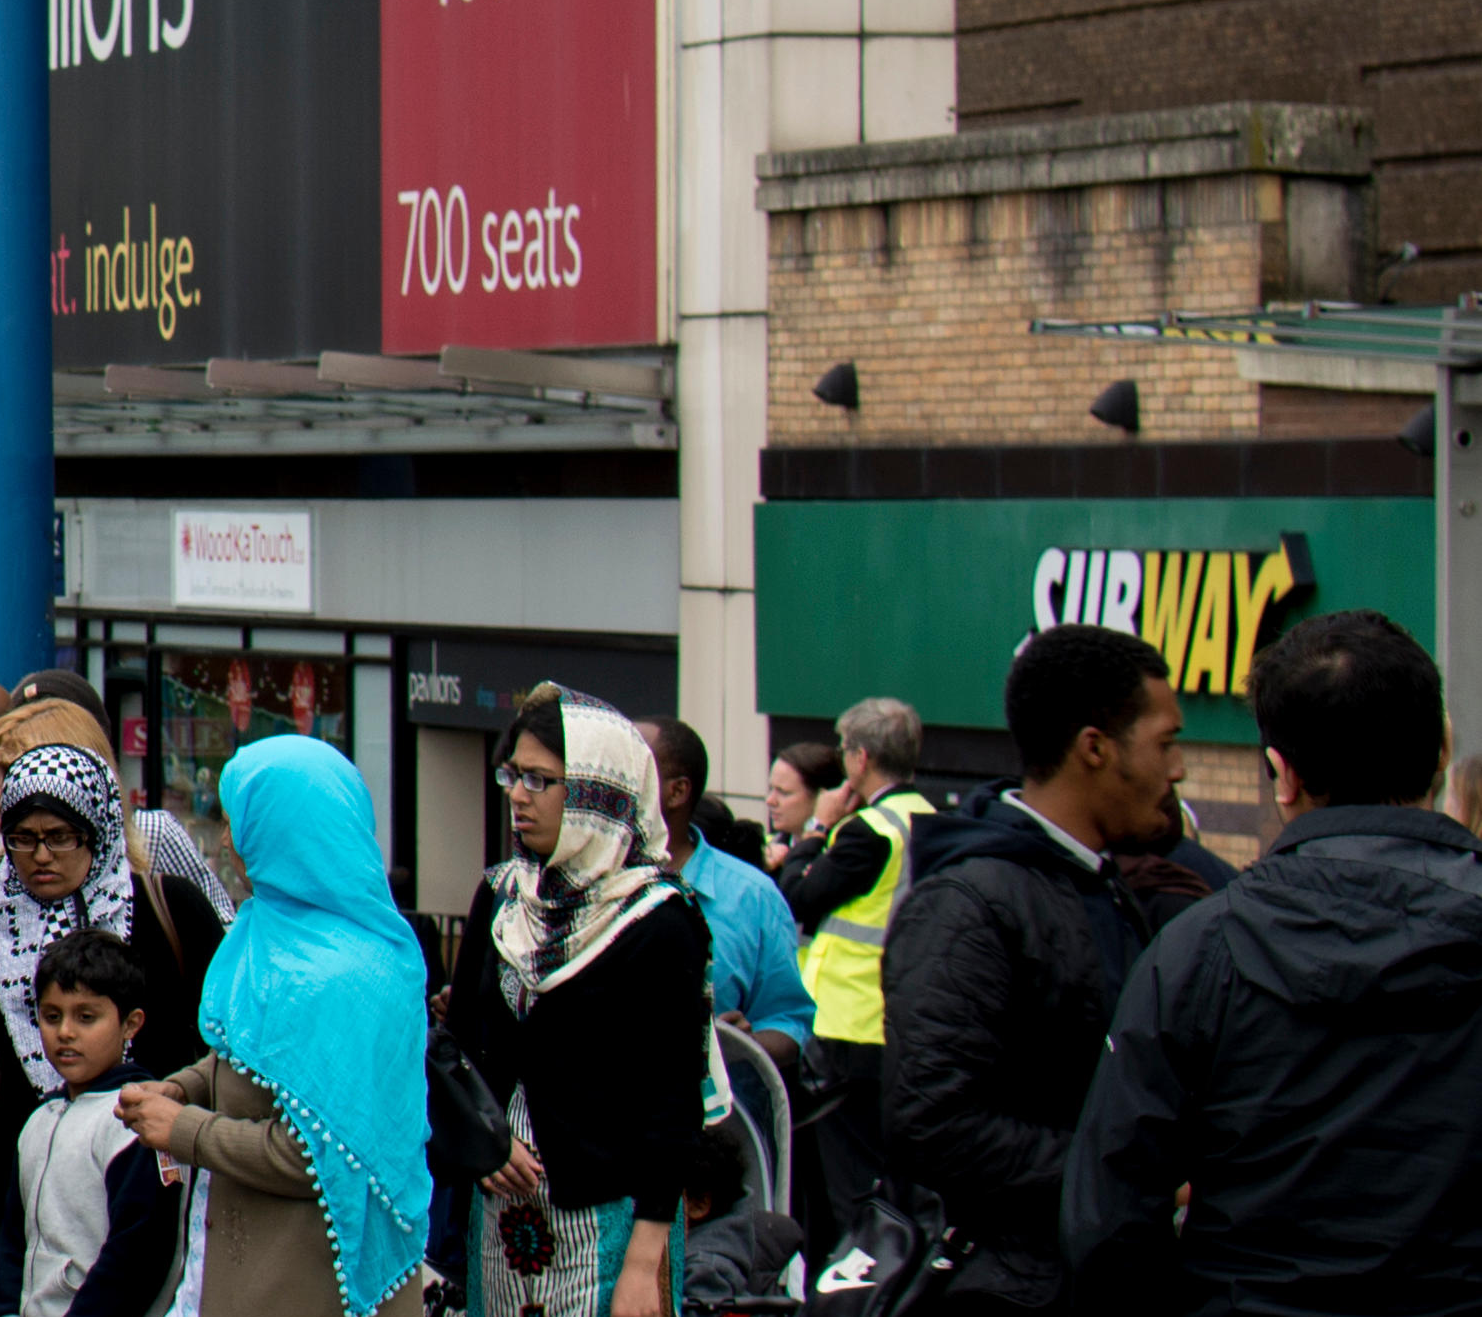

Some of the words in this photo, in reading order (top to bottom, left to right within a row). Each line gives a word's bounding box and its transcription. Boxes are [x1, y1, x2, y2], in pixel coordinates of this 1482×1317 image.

[85, 203, 201, 341] indulge.
[398, 185, 470, 297] 700
[481, 188, 582, 293] seats
